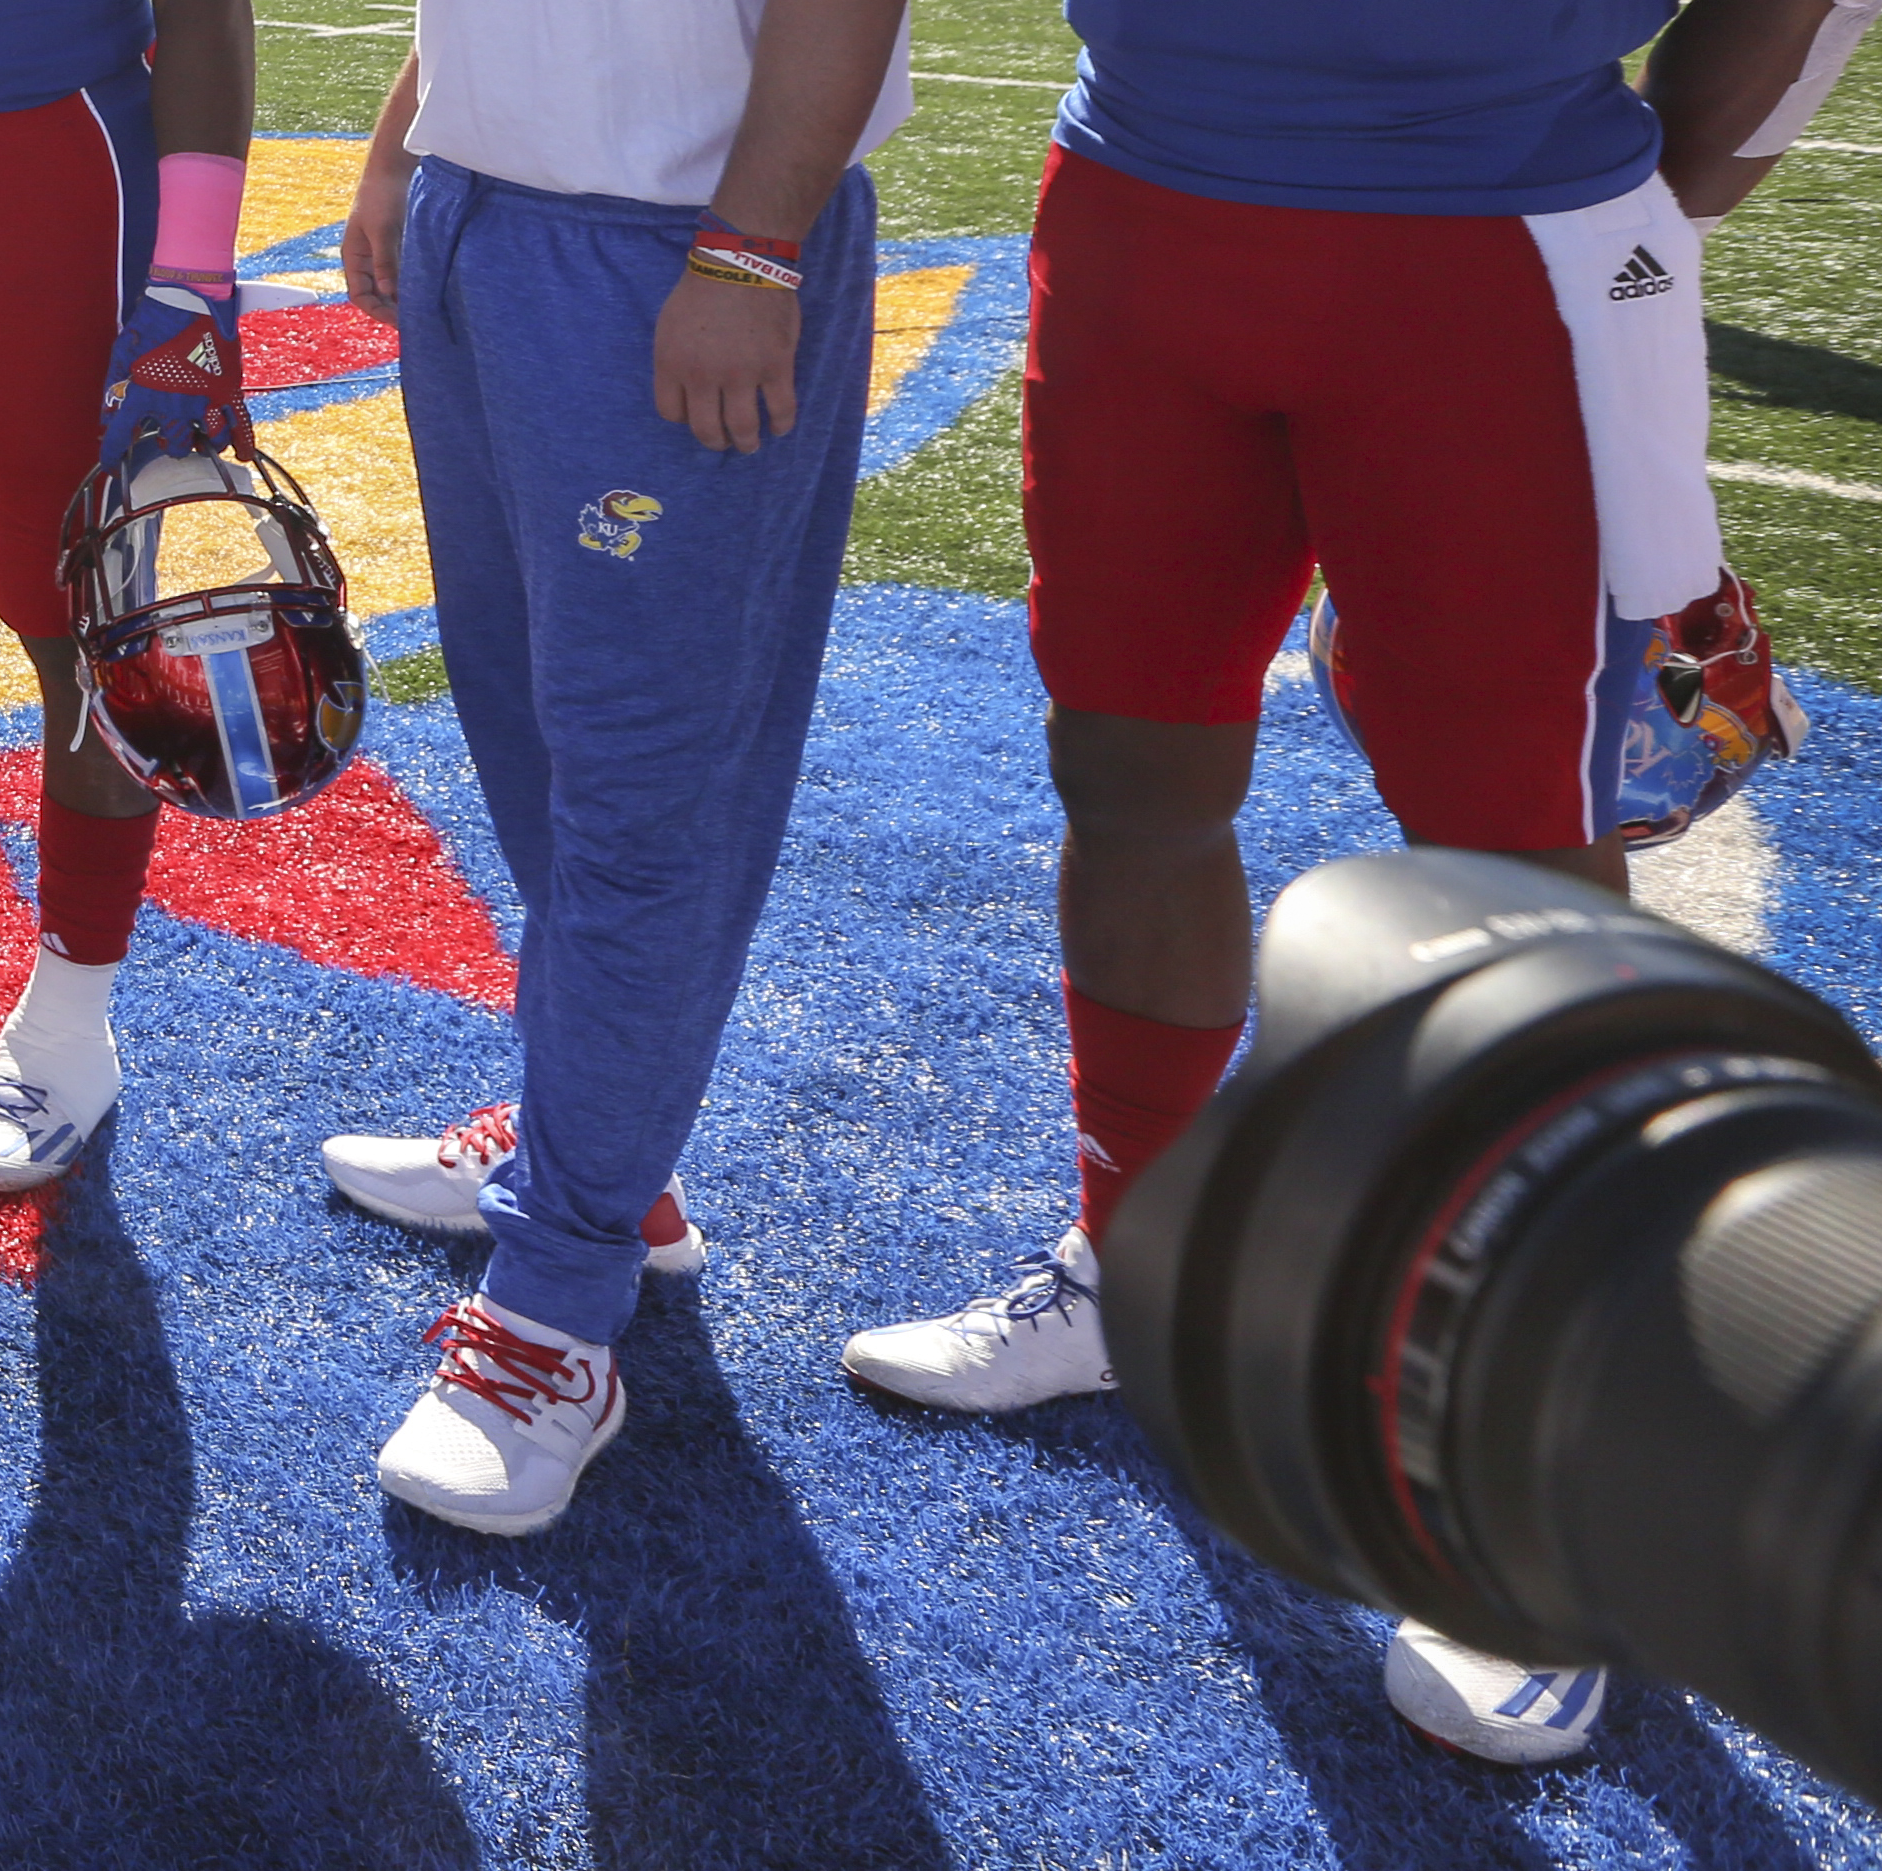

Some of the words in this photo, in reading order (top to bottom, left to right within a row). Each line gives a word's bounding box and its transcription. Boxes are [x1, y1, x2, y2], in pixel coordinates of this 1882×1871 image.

[1609, 276, 1675, 302] adidas
[202, 331, 223, 376] adidas
[603, 522, 623, 536] KU
